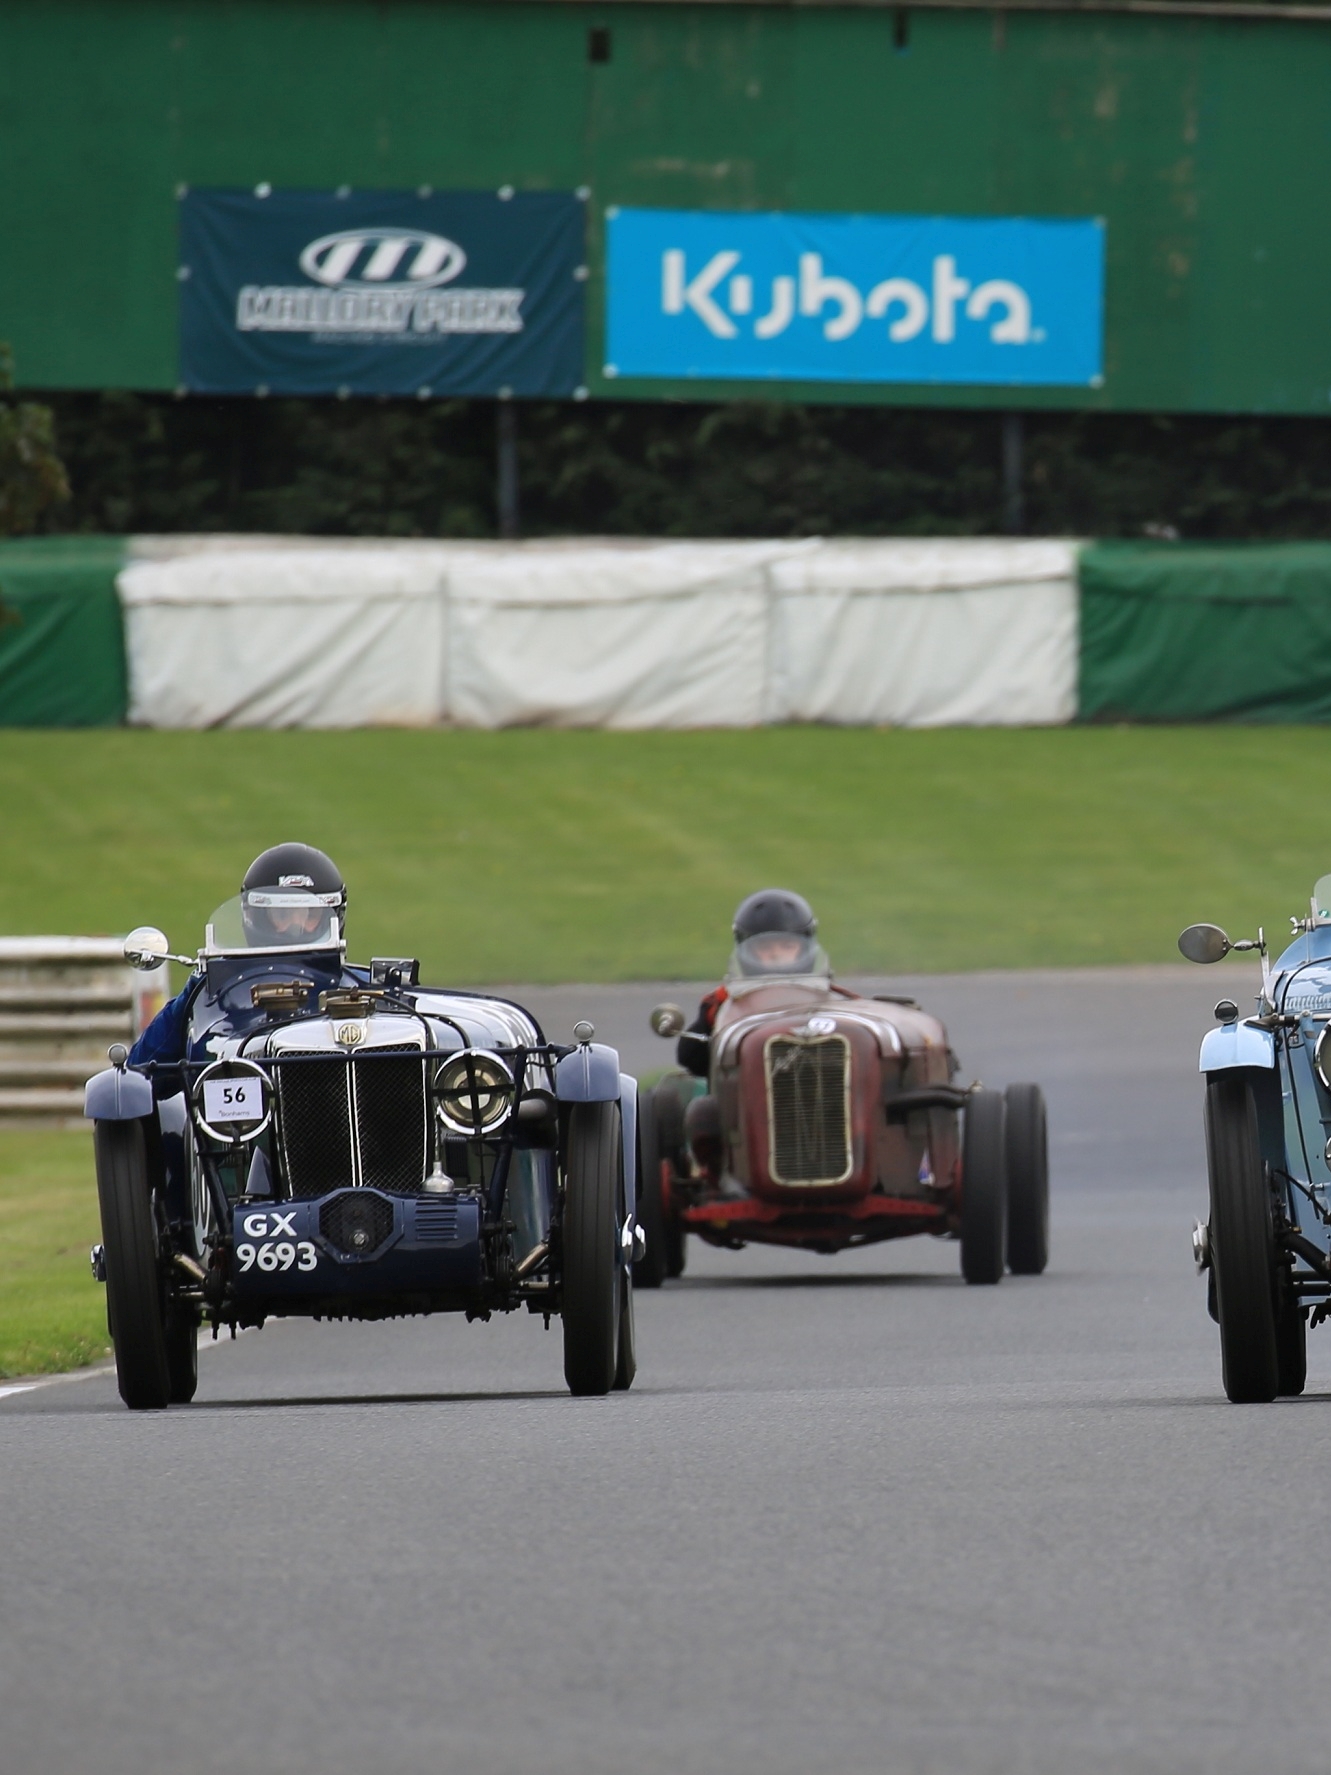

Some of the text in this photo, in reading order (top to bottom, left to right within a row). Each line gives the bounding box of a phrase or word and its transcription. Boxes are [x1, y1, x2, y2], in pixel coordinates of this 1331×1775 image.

[237, 285, 525, 333] MALLORY PARK
[661, 248, 1032, 345] Kubota
[341, 1025, 359, 1043] MG
[223, 1086, 246, 1104] 56
[243, 1211, 298, 1238] GX
[236, 1241, 318, 1272] 9693
